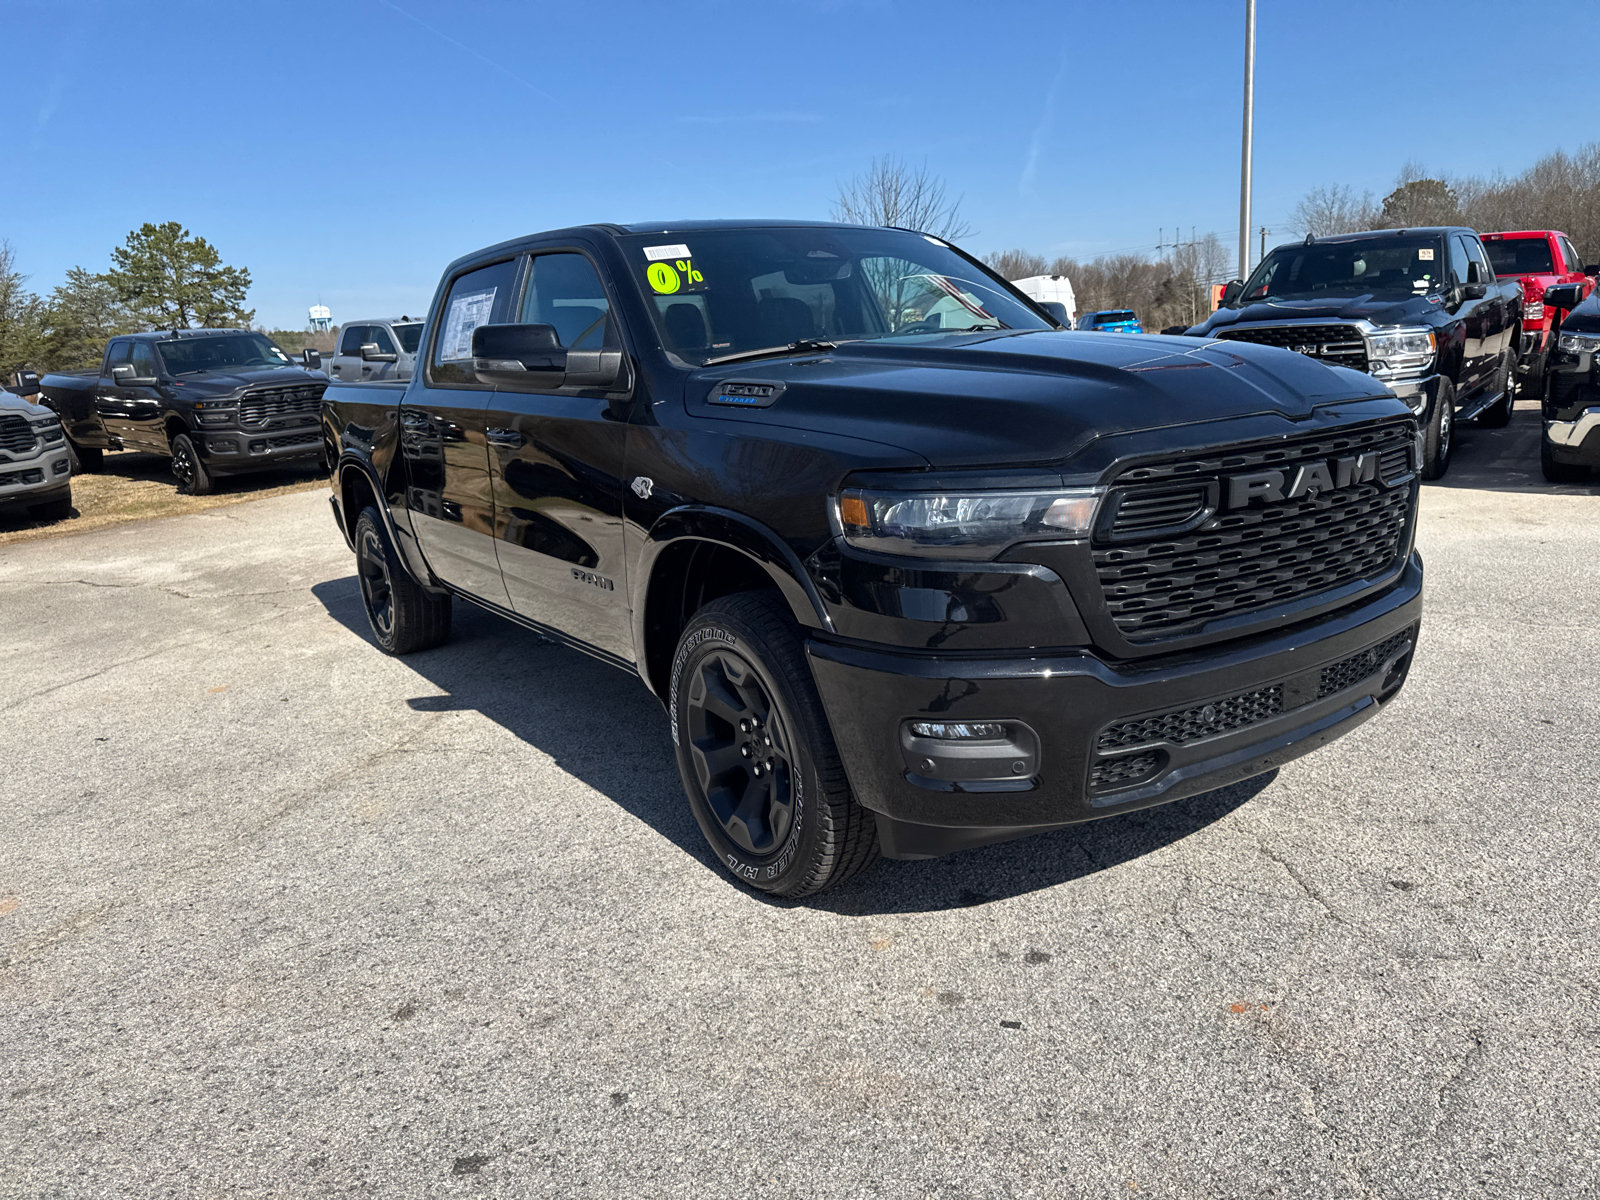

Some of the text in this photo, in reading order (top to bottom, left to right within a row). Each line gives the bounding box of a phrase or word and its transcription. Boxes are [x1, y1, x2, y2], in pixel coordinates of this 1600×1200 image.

[647, 260, 704, 294] 0%
[720, 384, 774, 397] 1500
[1228, 451, 1378, 509] RAM
[571, 568, 614, 591] RAM
[670, 627, 736, 747] BRIDGESTONE
[727, 854, 759, 880] H/L
